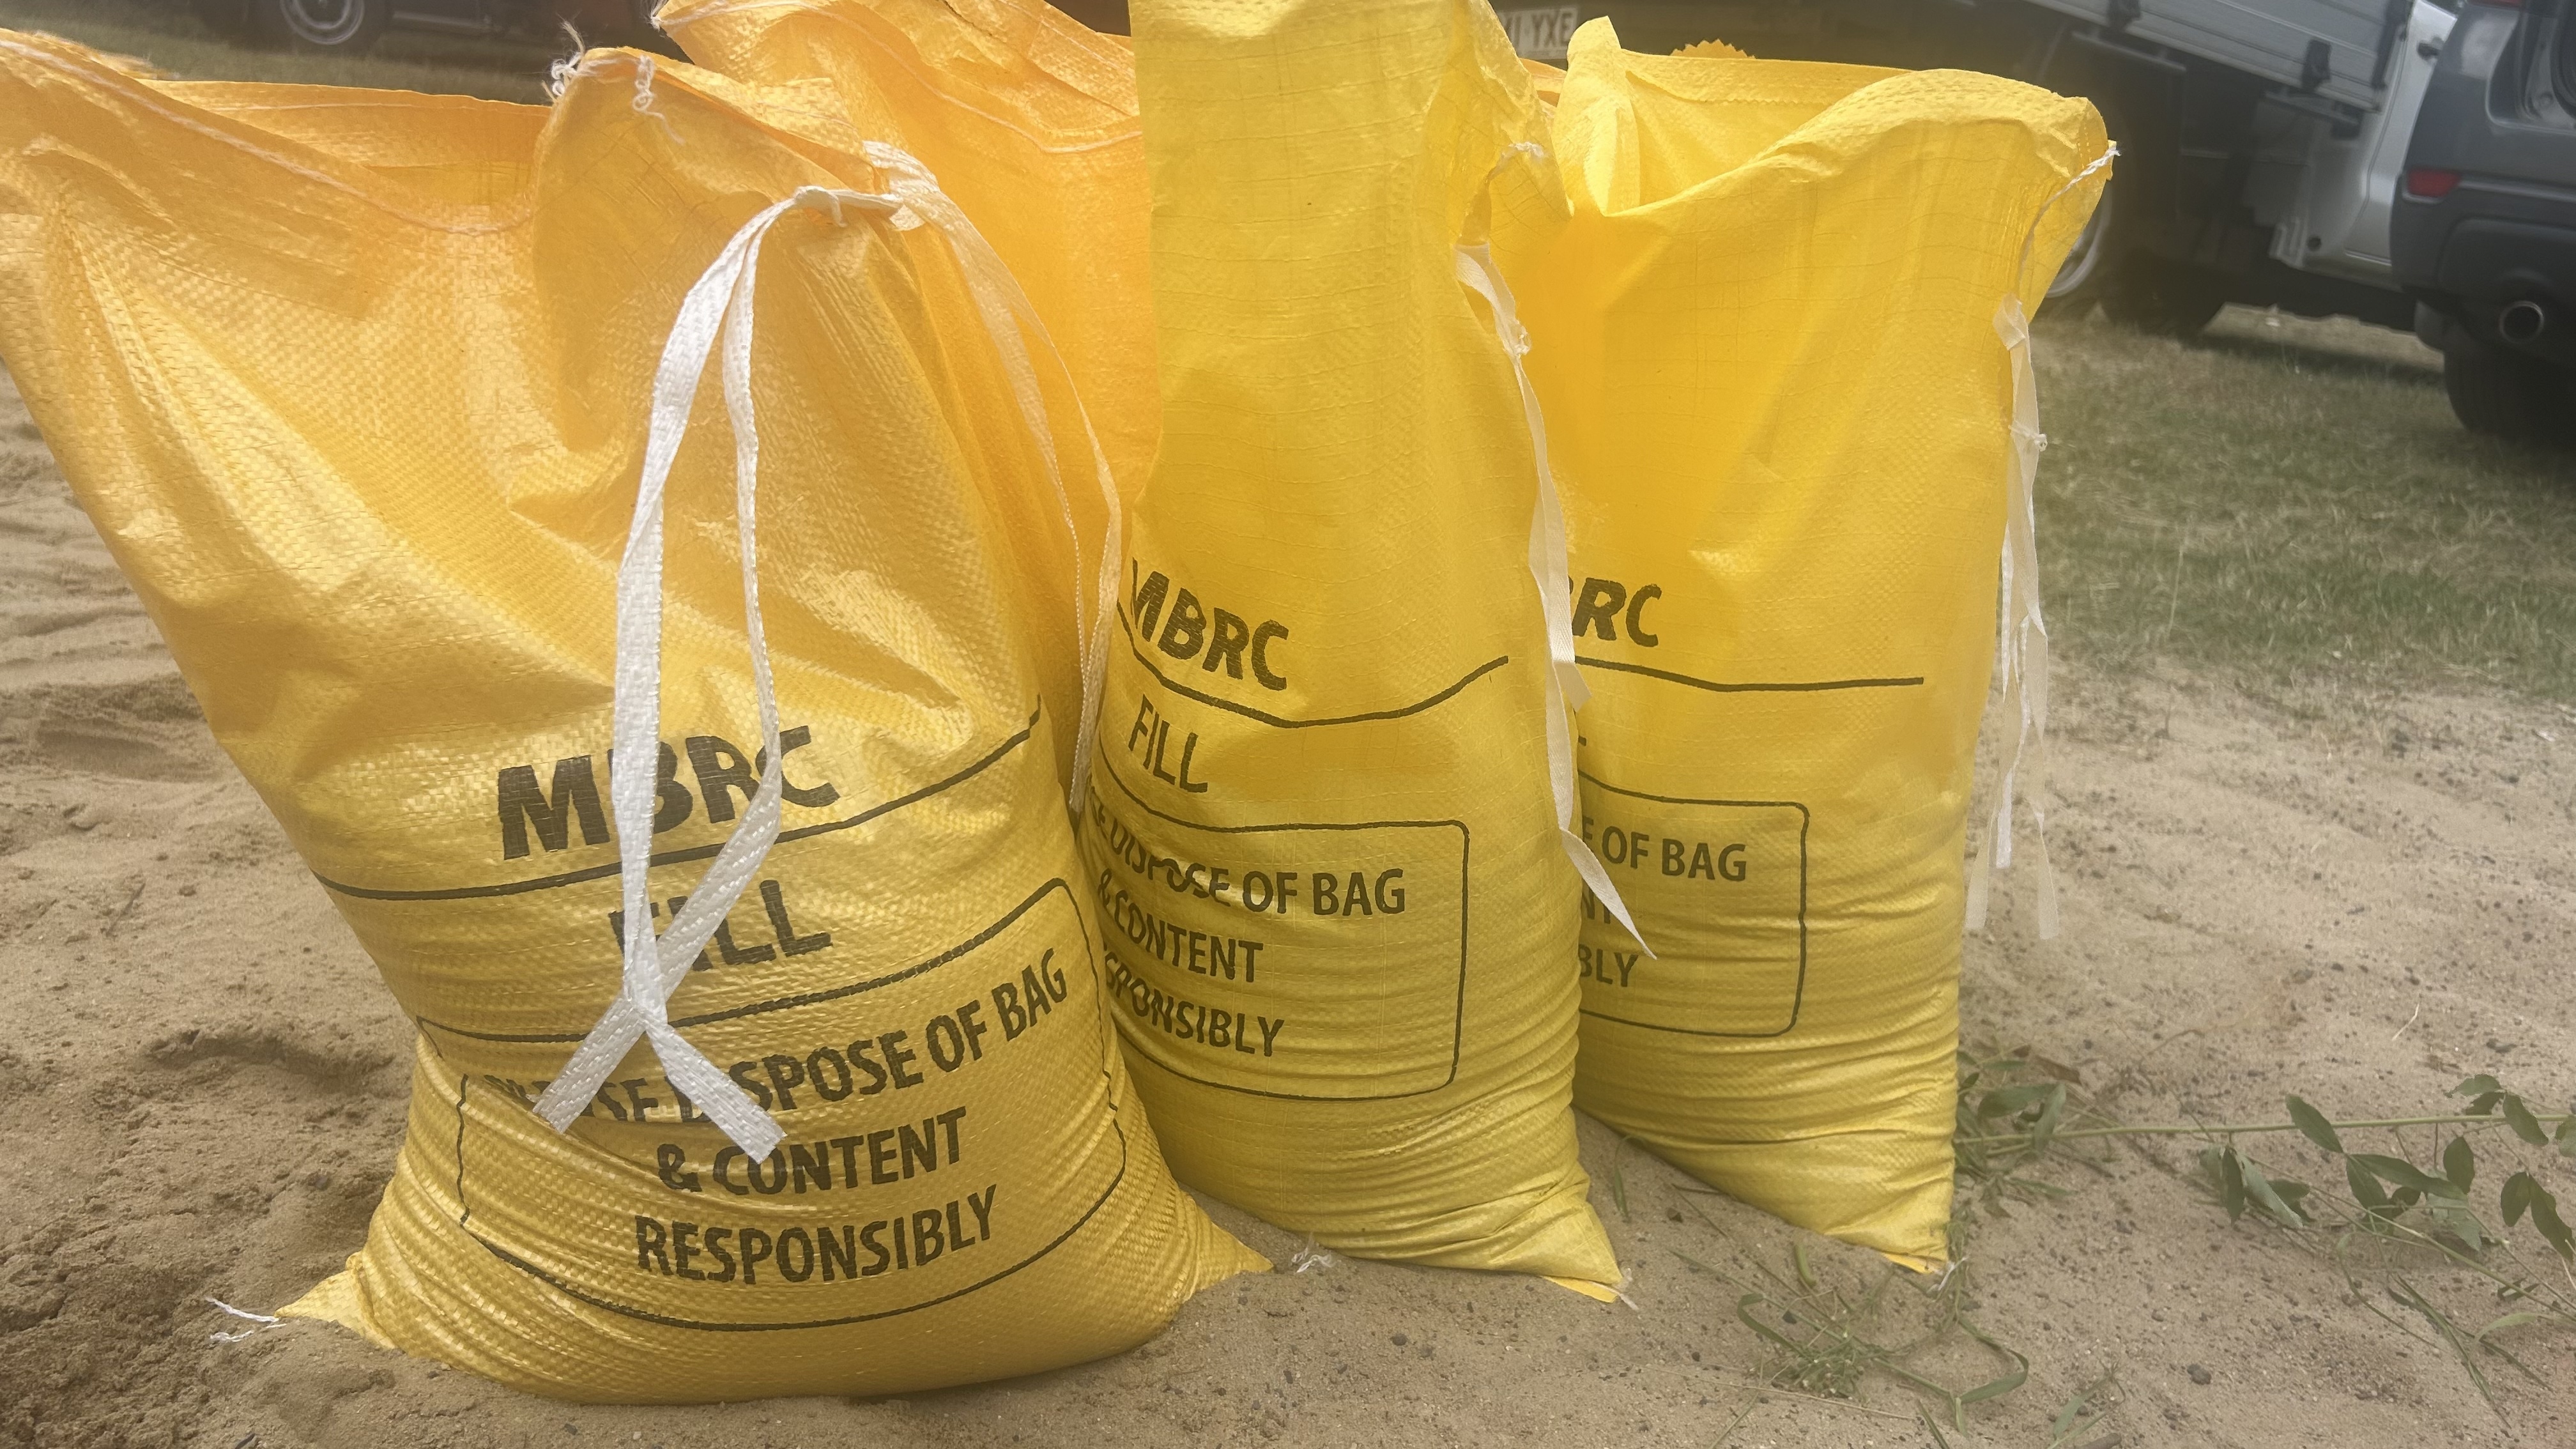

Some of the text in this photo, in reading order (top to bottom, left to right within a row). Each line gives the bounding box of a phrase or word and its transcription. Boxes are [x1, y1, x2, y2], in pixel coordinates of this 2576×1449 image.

[1130, 557, 1289, 691] MBRC
[1568, 575, 1662, 647] RC
[498, 725, 841, 860] MBRC
[1128, 693, 1208, 793] FILL
[1242, 871, 1298, 914] OF
[1312, 868, 1406, 916] BAG
[1601, 825, 1650, 870] OF
[1661, 838, 1747, 882] BAG
[1114, 889, 1264, 983] CONTENT
[664, 1031, 923, 1123] SPOSE
[926, 1000, 988, 1073] OF
[992, 947, 1068, 1042] BAG
[1103, 942, 1285, 1057] SPONSIBLY
[657, 1106, 967, 1197] & CONTENT
[634, 1184, 997, 1285] RESPONSIBLY
